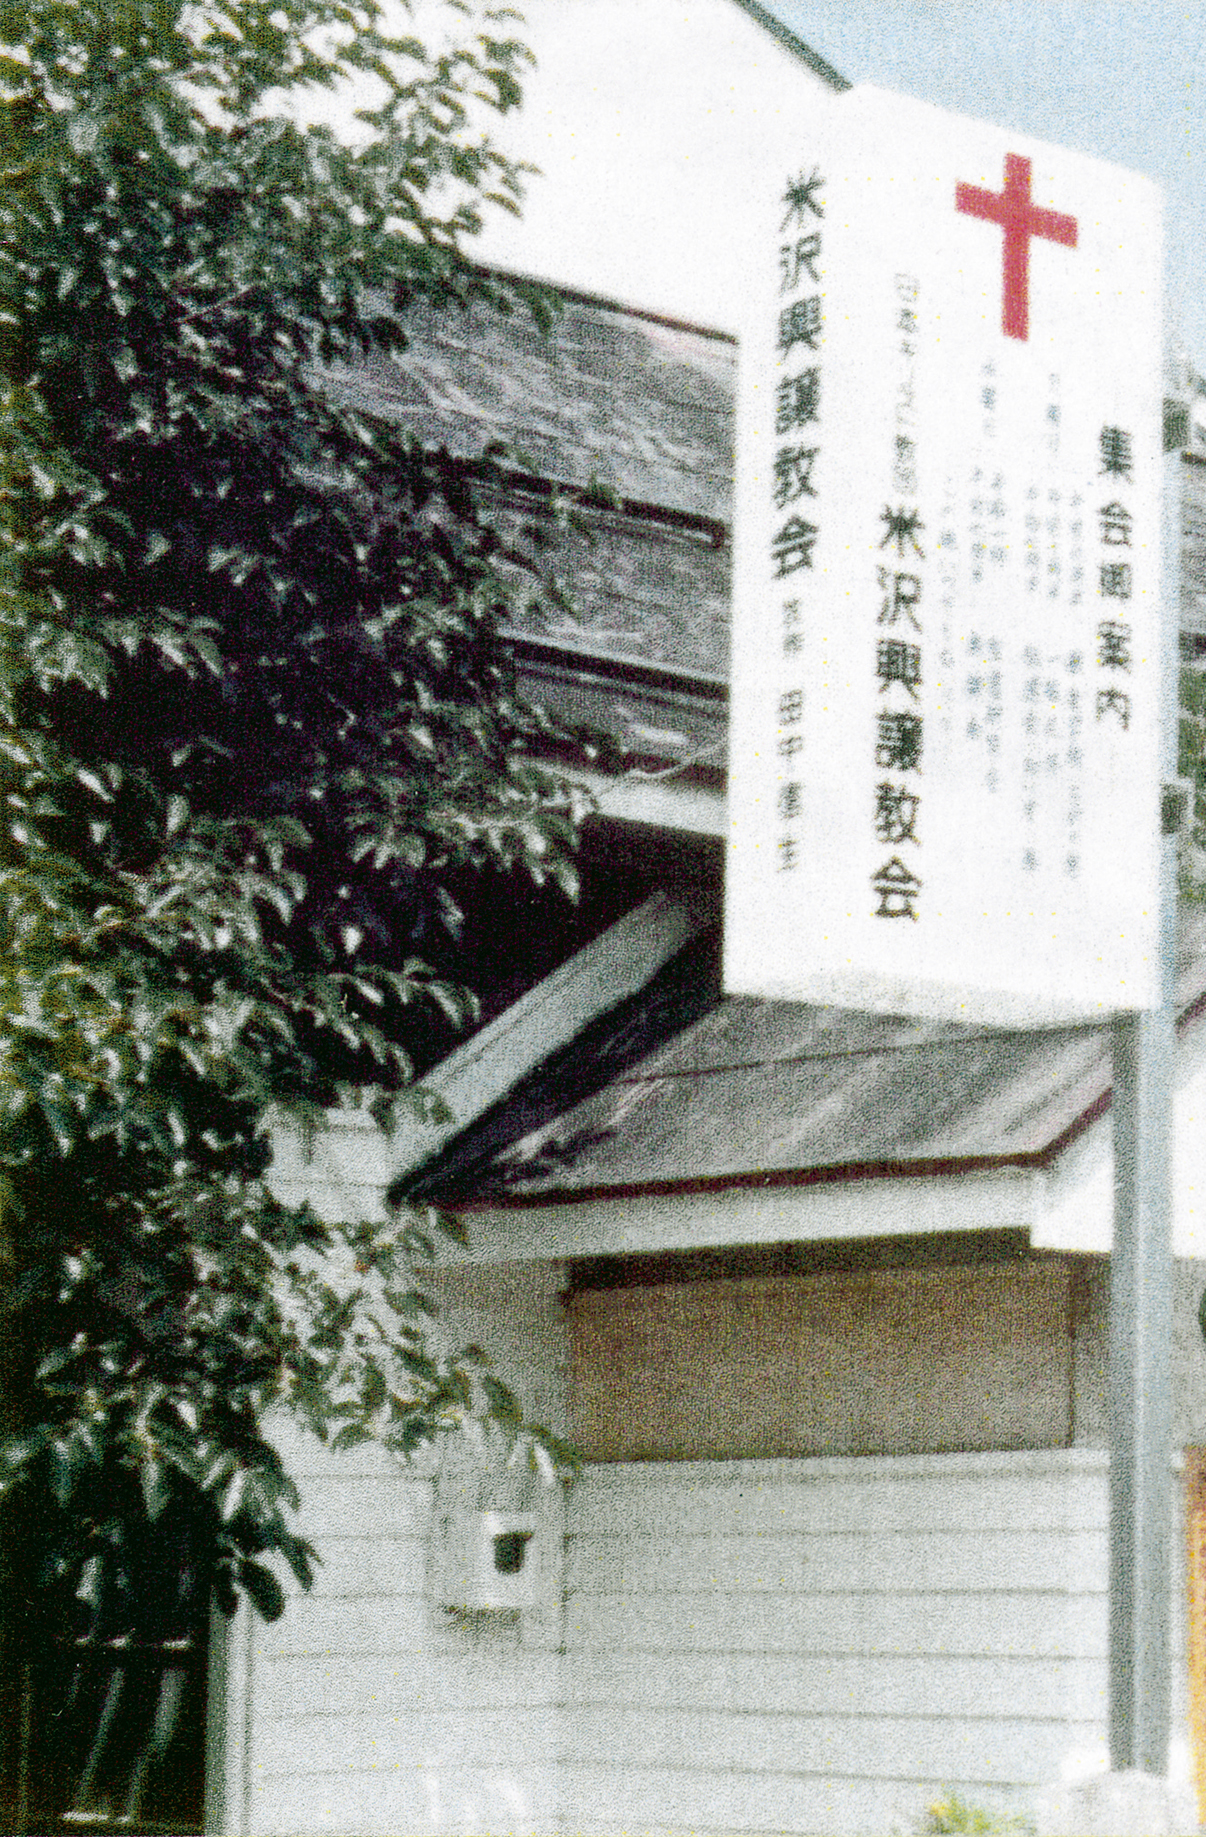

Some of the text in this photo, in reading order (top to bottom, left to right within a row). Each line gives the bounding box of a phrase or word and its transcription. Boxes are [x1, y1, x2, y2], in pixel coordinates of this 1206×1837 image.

[770, 166, 826, 582] 米沢興譲教会
[870, 504, 926, 922] 米沢興譲教会
